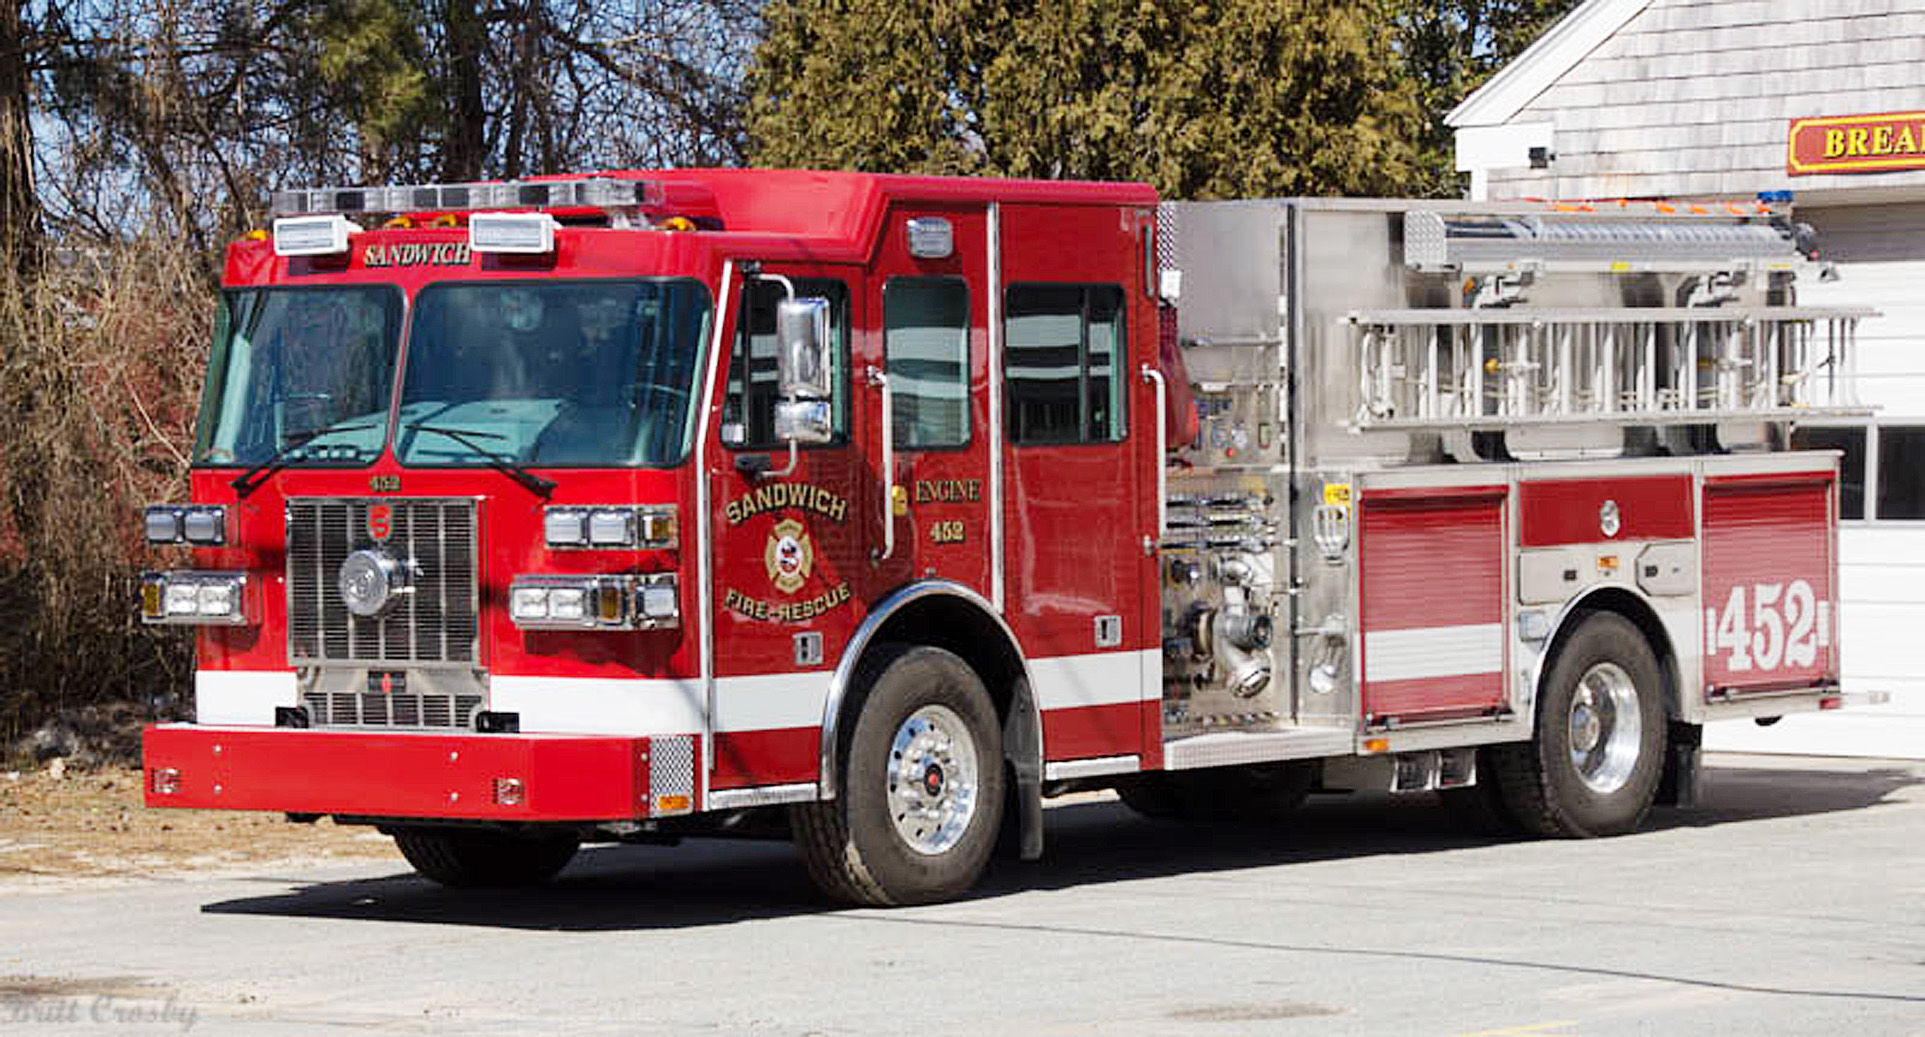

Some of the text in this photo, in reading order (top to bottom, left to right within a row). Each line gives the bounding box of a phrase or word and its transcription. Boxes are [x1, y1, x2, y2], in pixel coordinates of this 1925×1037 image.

[1823, 124, 1925, 158] BREA
[364, 242, 471, 267] SANDWICH
[726, 482, 847, 524] SANDWICH
[916, 479, 981, 503] ENGINE
[930, 520, 966, 543] 452
[724, 579, 850, 622] FIRE-RESCUE
[1717, 579, 1817, 672] 452
